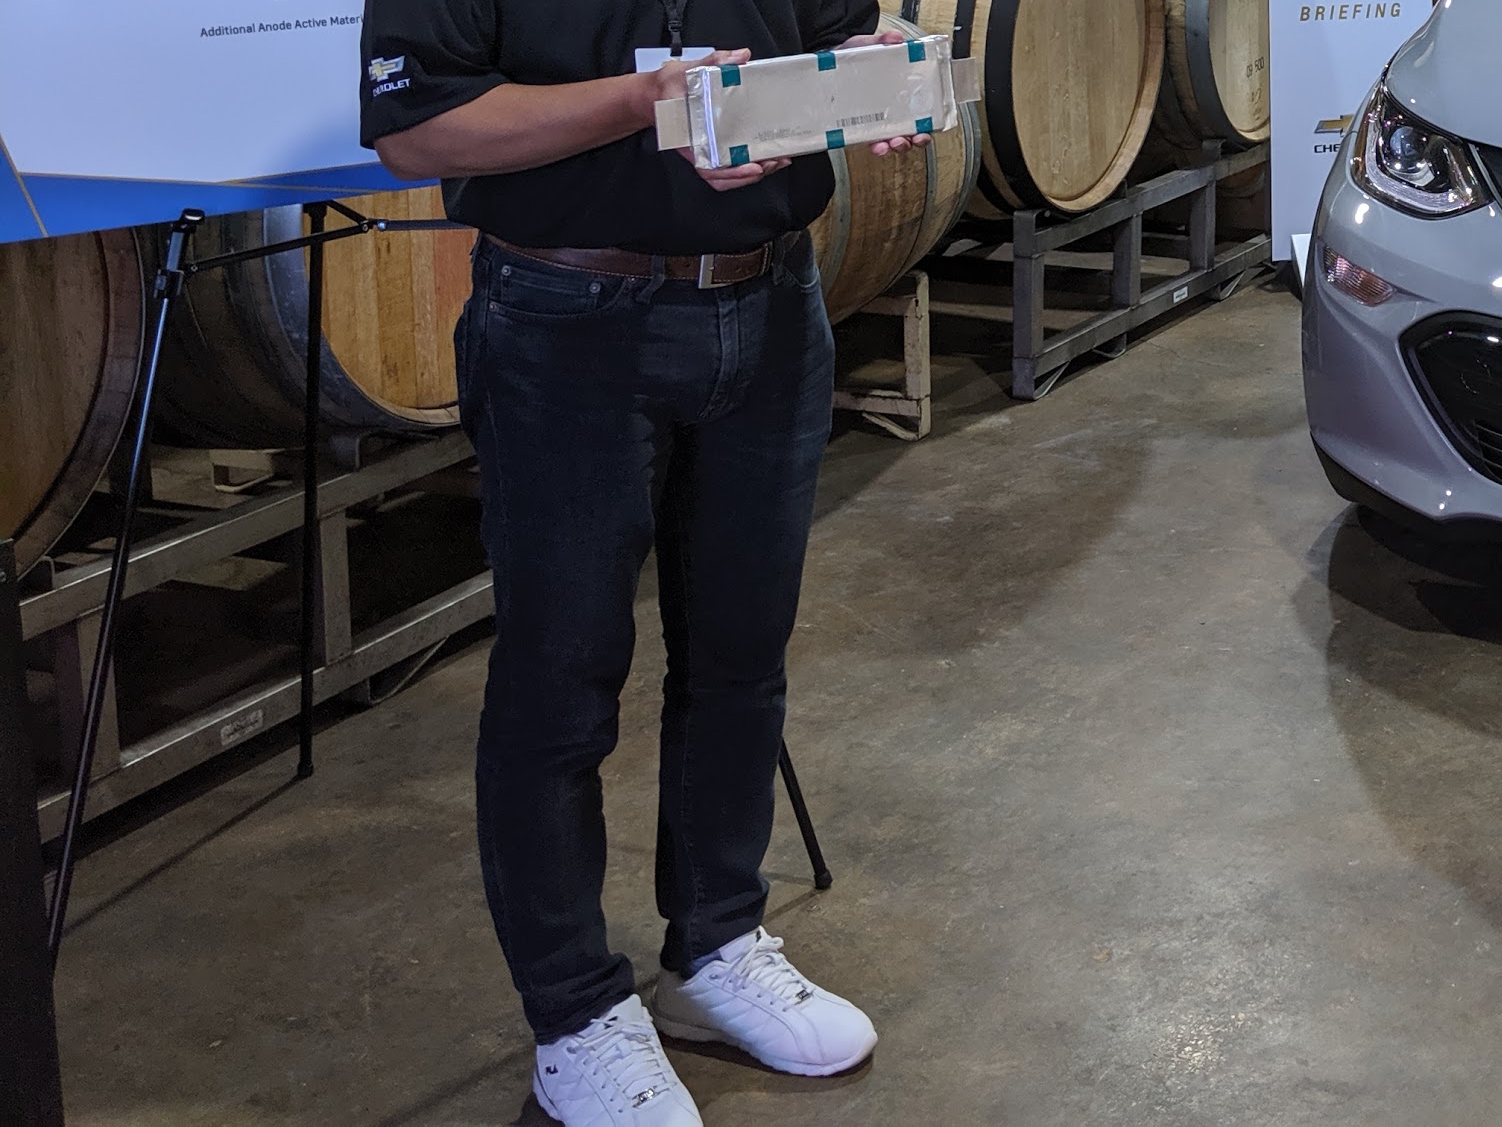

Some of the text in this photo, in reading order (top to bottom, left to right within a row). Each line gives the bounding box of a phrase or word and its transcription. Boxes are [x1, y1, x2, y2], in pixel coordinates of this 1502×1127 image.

[1299, 2, 1401, 22] BRIEFING
[200, 13, 364, 38] Additional Anode Active Materi
[1313, 143, 1342, 154] CHE
